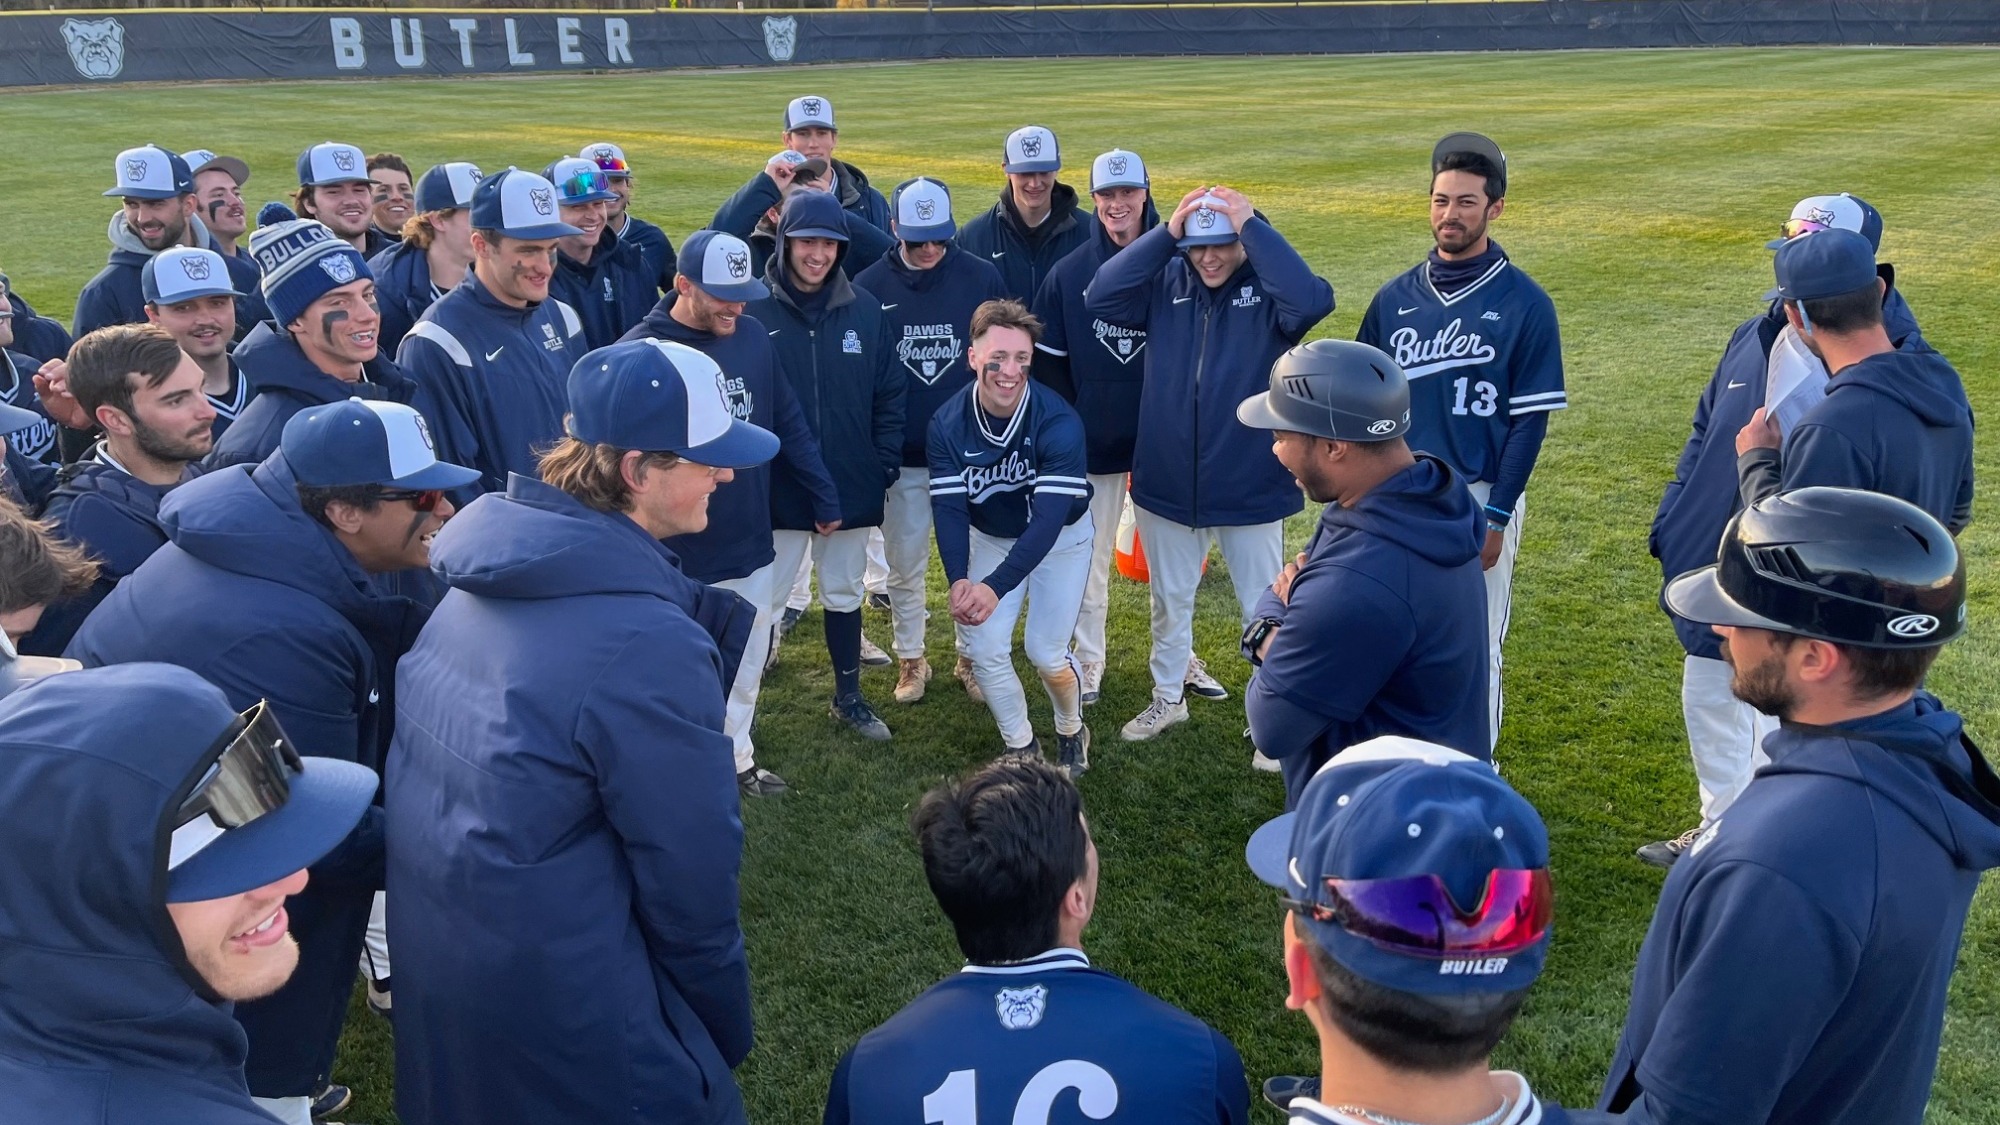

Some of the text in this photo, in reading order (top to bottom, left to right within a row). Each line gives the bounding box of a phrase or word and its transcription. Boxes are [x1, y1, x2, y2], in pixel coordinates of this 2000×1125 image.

[330, 17, 633, 69] BUTLER
[1232, 296, 1261, 305] BUTLER
[904, 323, 953, 336] DAWGS
[1390, 318, 1495, 368] Butler
[896, 339, 962, 361] Baseball
[1452, 377, 1498, 417] 13
[960, 451, 1036, 498] Butler
[1439, 958, 1508, 975] BUTLER
